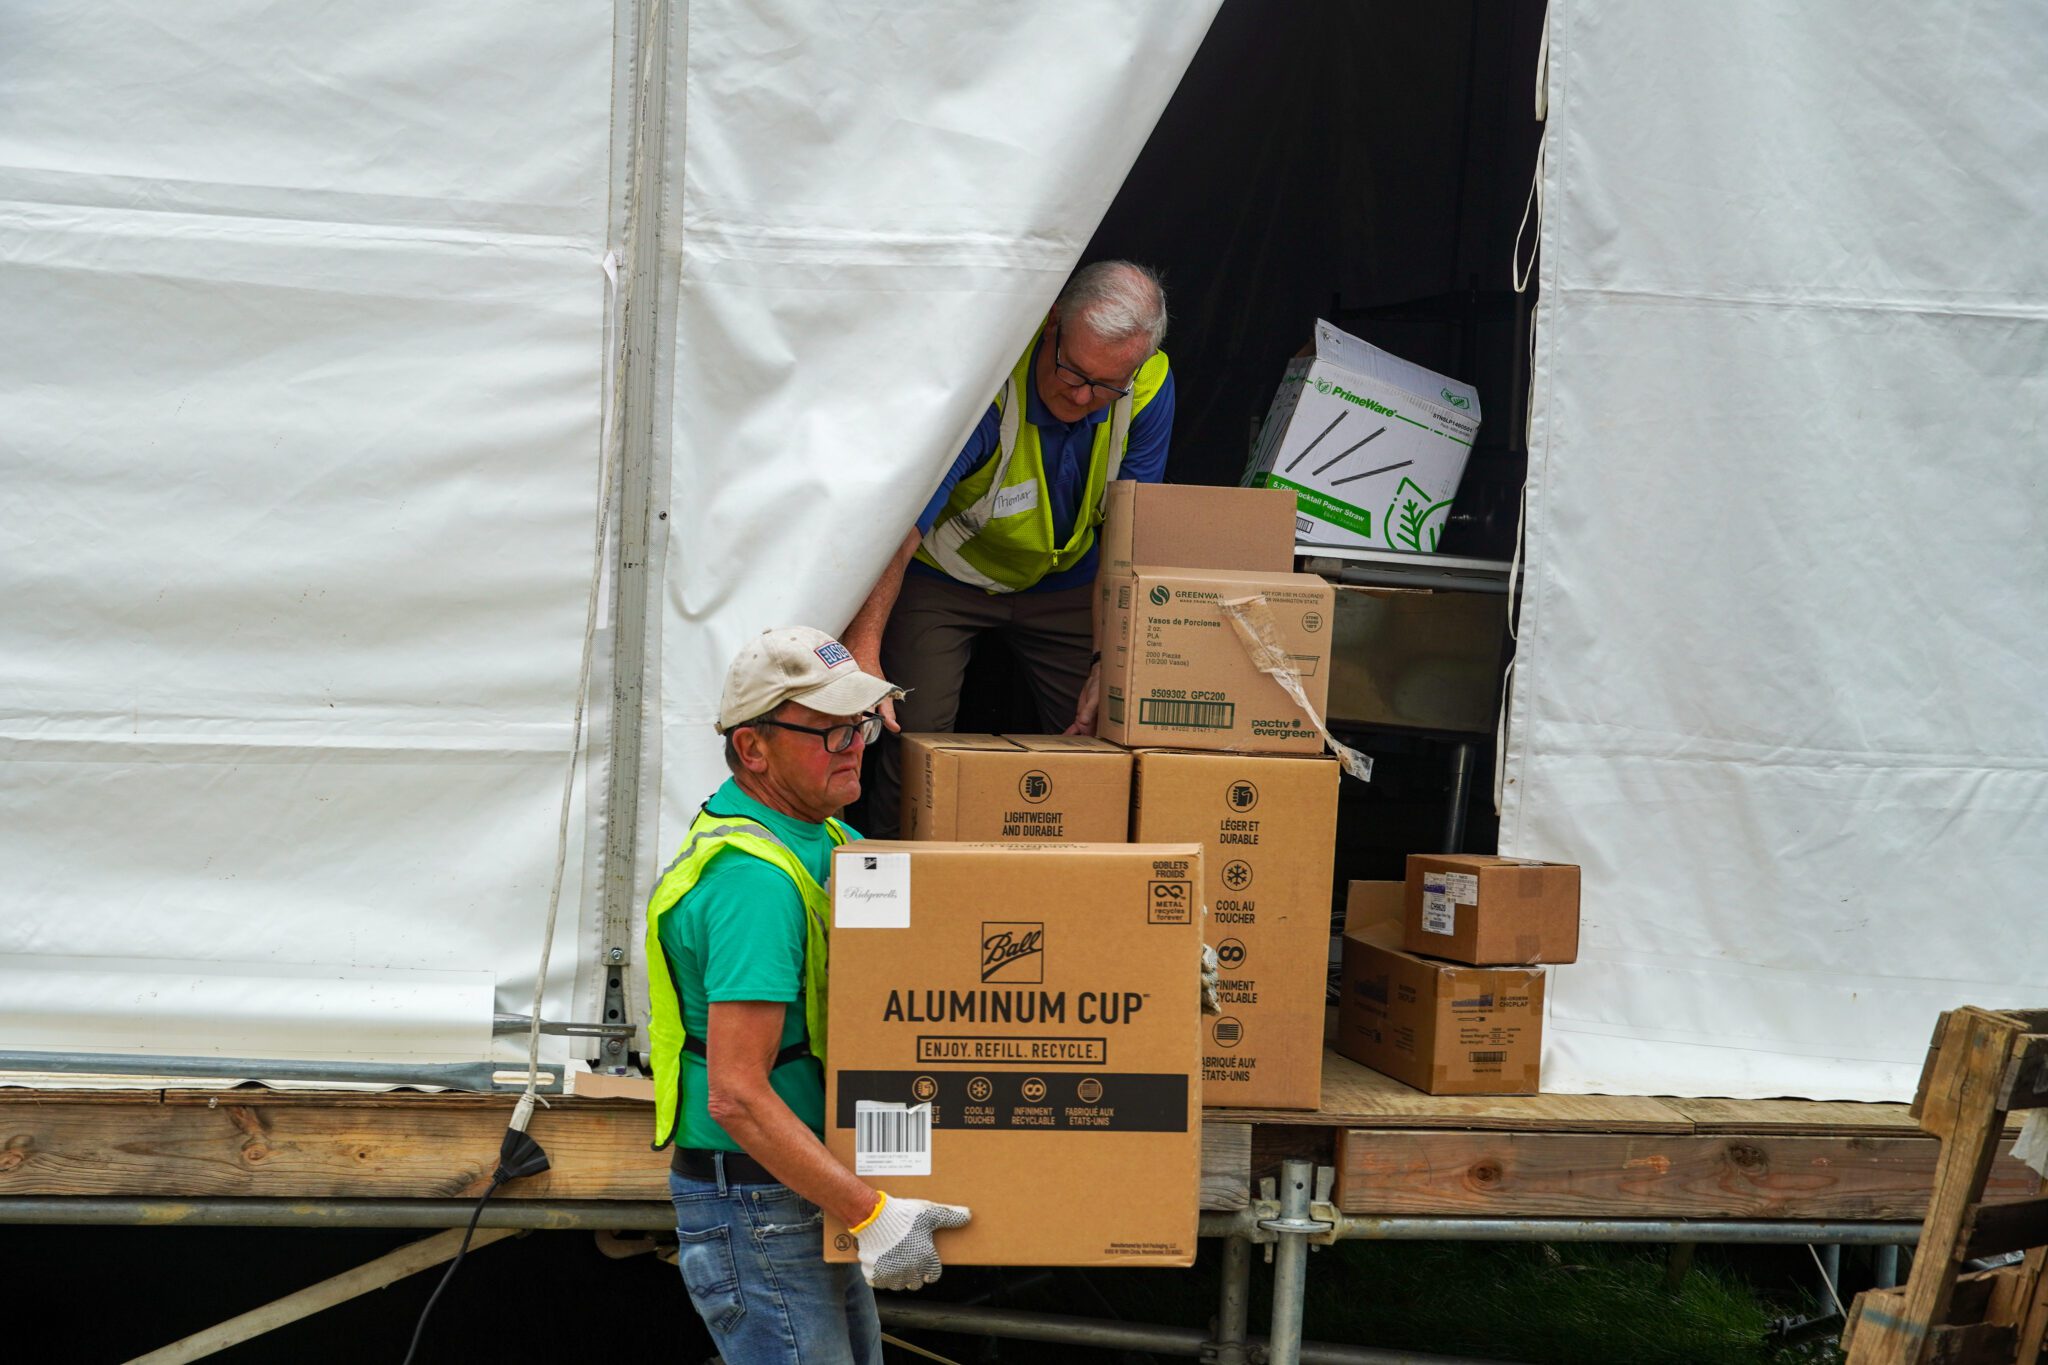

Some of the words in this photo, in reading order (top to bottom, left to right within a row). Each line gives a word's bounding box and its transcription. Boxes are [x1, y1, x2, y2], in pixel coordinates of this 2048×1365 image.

[1332, 386, 1394, 417] PrimeWare
[1322, 500, 1344, 514] Paper
[1344, 509, 1366, 523] Straw
[1148, 616, 1171, 625] Vasos
[1184, 618, 1221, 628] Porciones
[1151, 689, 1186, 700] 9509302
[1191, 691, 1226, 701] GPC200
[1251, 718, 1290, 729] pactiv
[1254, 727, 1316, 739] evergreen
[1004, 811, 1063, 824] LIGHTWEIGHT
[1220, 818, 1247, 831] LÉGER
[1249, 821, 1260, 831] ET
[1002, 825, 1020, 837] AND
[1022, 825, 1063, 837] DURABLE
[1220, 833, 1259, 845] DURABLE
[1152, 861, 1189, 870] GOBLETS
[1155, 870, 1185, 878] FROIDS
[1216, 900, 1240, 911] COOL
[1242, 901, 1255, 912] AU
[1214, 912, 1255, 924] TOUCHER
[983, 930, 1042, 965] Ball
[1215, 980, 1255, 991] FINIMENT
[1215, 992, 1257, 1004] CYCLABLE
[883, 990, 1066, 1023] ALUMINUM
[1078, 991, 1143, 1024] CUP
[925, 1042, 971, 1058] ENJOY.
[975, 1042, 1028, 1058] REFILL.
[1032, 1043, 1098, 1059] RECYCLE.
[1238, 1057, 1256, 1069] AUX
[964, 1106, 982, 1115] COOL
[984, 1107, 995, 1115] AU
[1014, 1107, 1053, 1116] INFINIMENT
[1065, 1106, 1098, 1117] FABRIQUÉ
[1099, 1107, 1114, 1117] AUX
[964, 1116, 995, 1125] TOUCHER
[1011, 1116, 1055, 1126] RECYCLABLE
